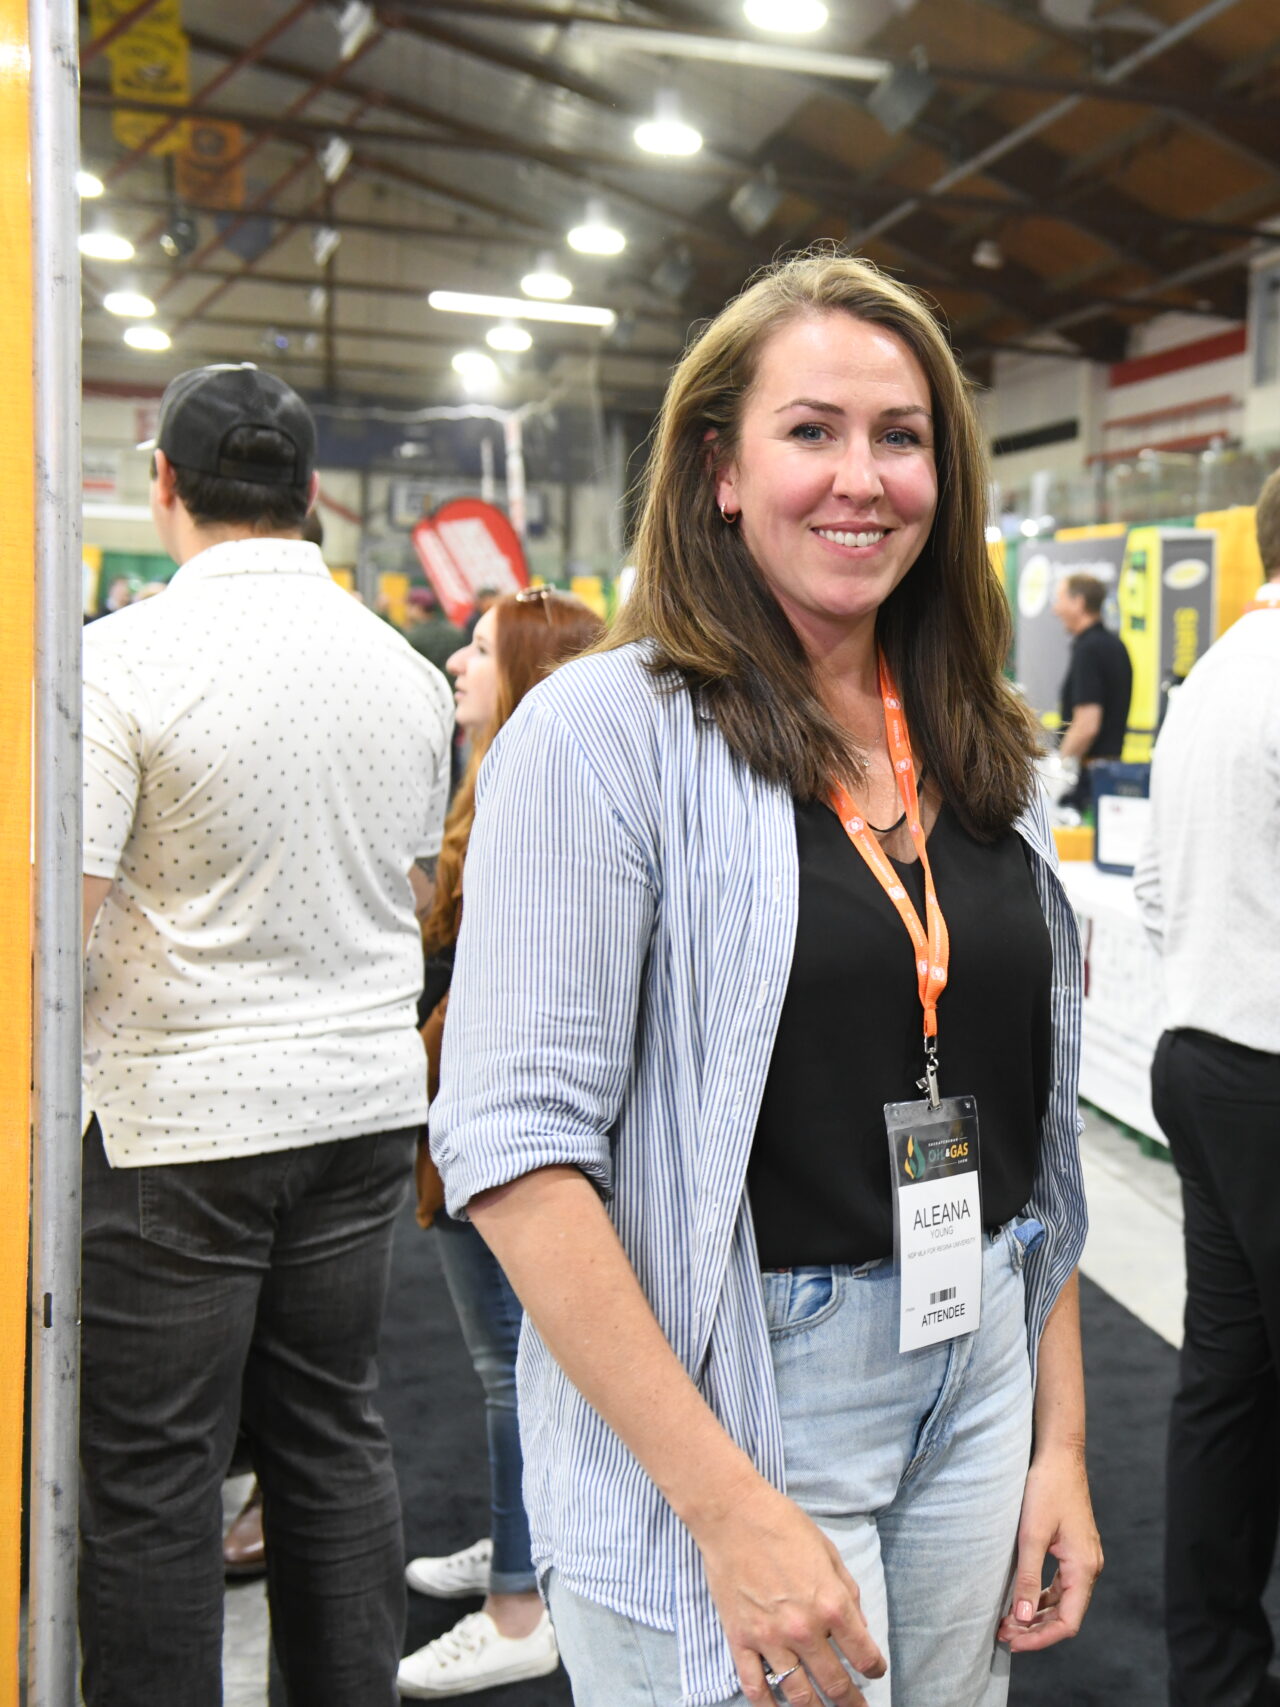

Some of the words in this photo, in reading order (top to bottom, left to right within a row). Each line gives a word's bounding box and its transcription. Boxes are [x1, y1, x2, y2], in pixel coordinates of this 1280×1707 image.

[913, 1198, 971, 1231] ALEANA
[930, 1225, 954, 1239] YOUNG
[921, 1303, 966, 1328] ATTENDEE
